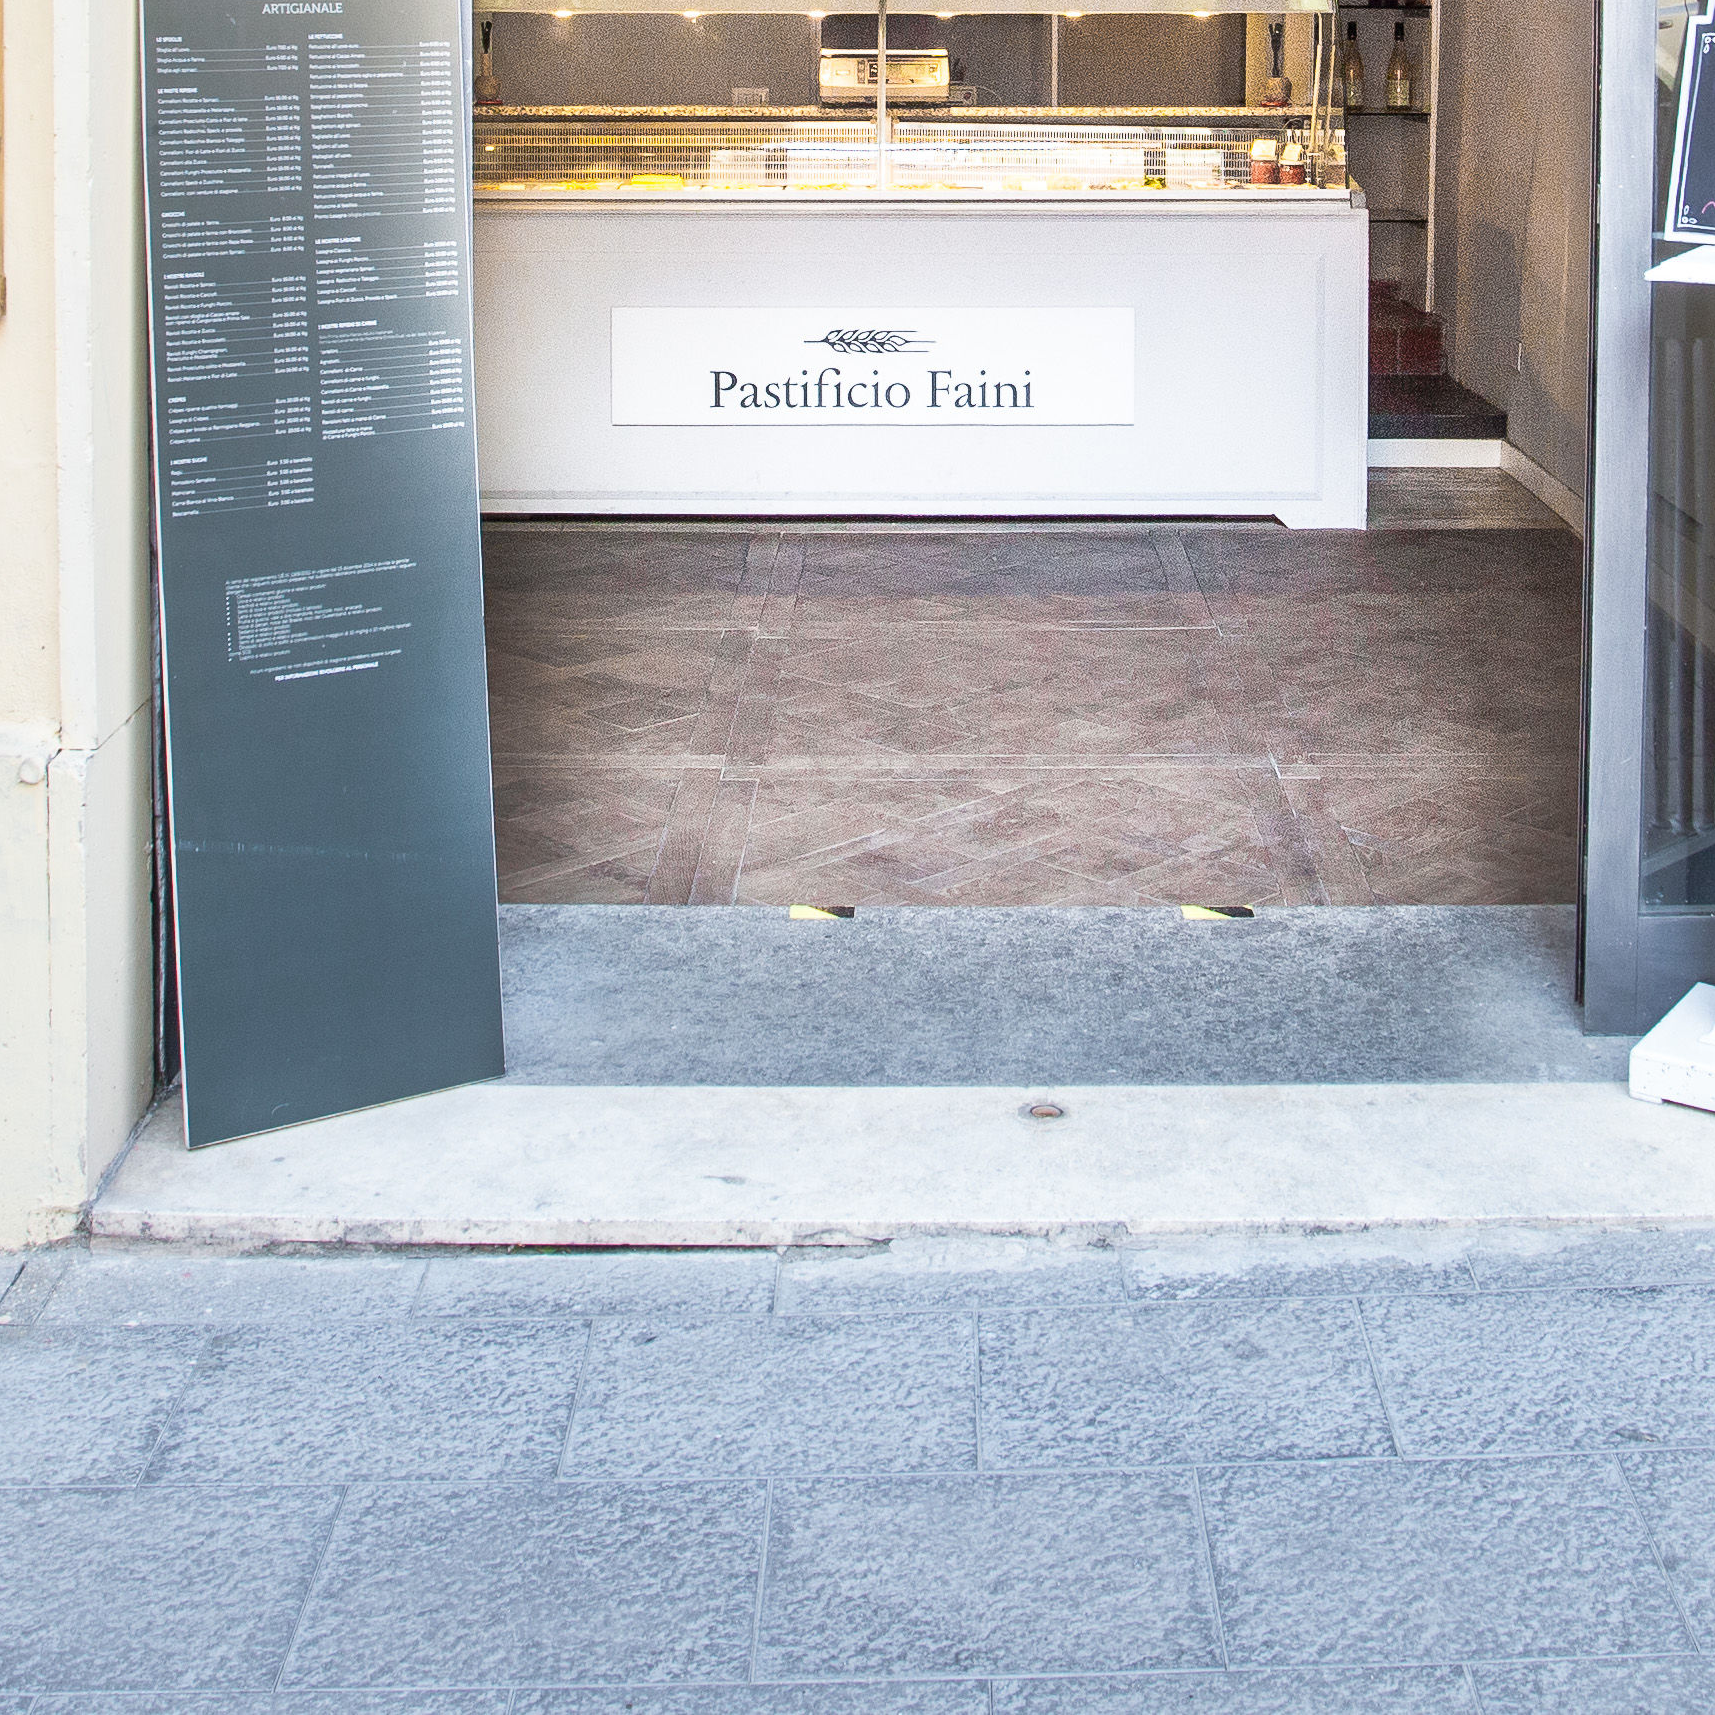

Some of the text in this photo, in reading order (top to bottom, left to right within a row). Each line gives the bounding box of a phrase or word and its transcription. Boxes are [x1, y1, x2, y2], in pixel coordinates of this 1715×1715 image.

[261, 2, 344, 15] ARTIGIANALE
[709, 368, 1036, 409] Pastificio Faini
